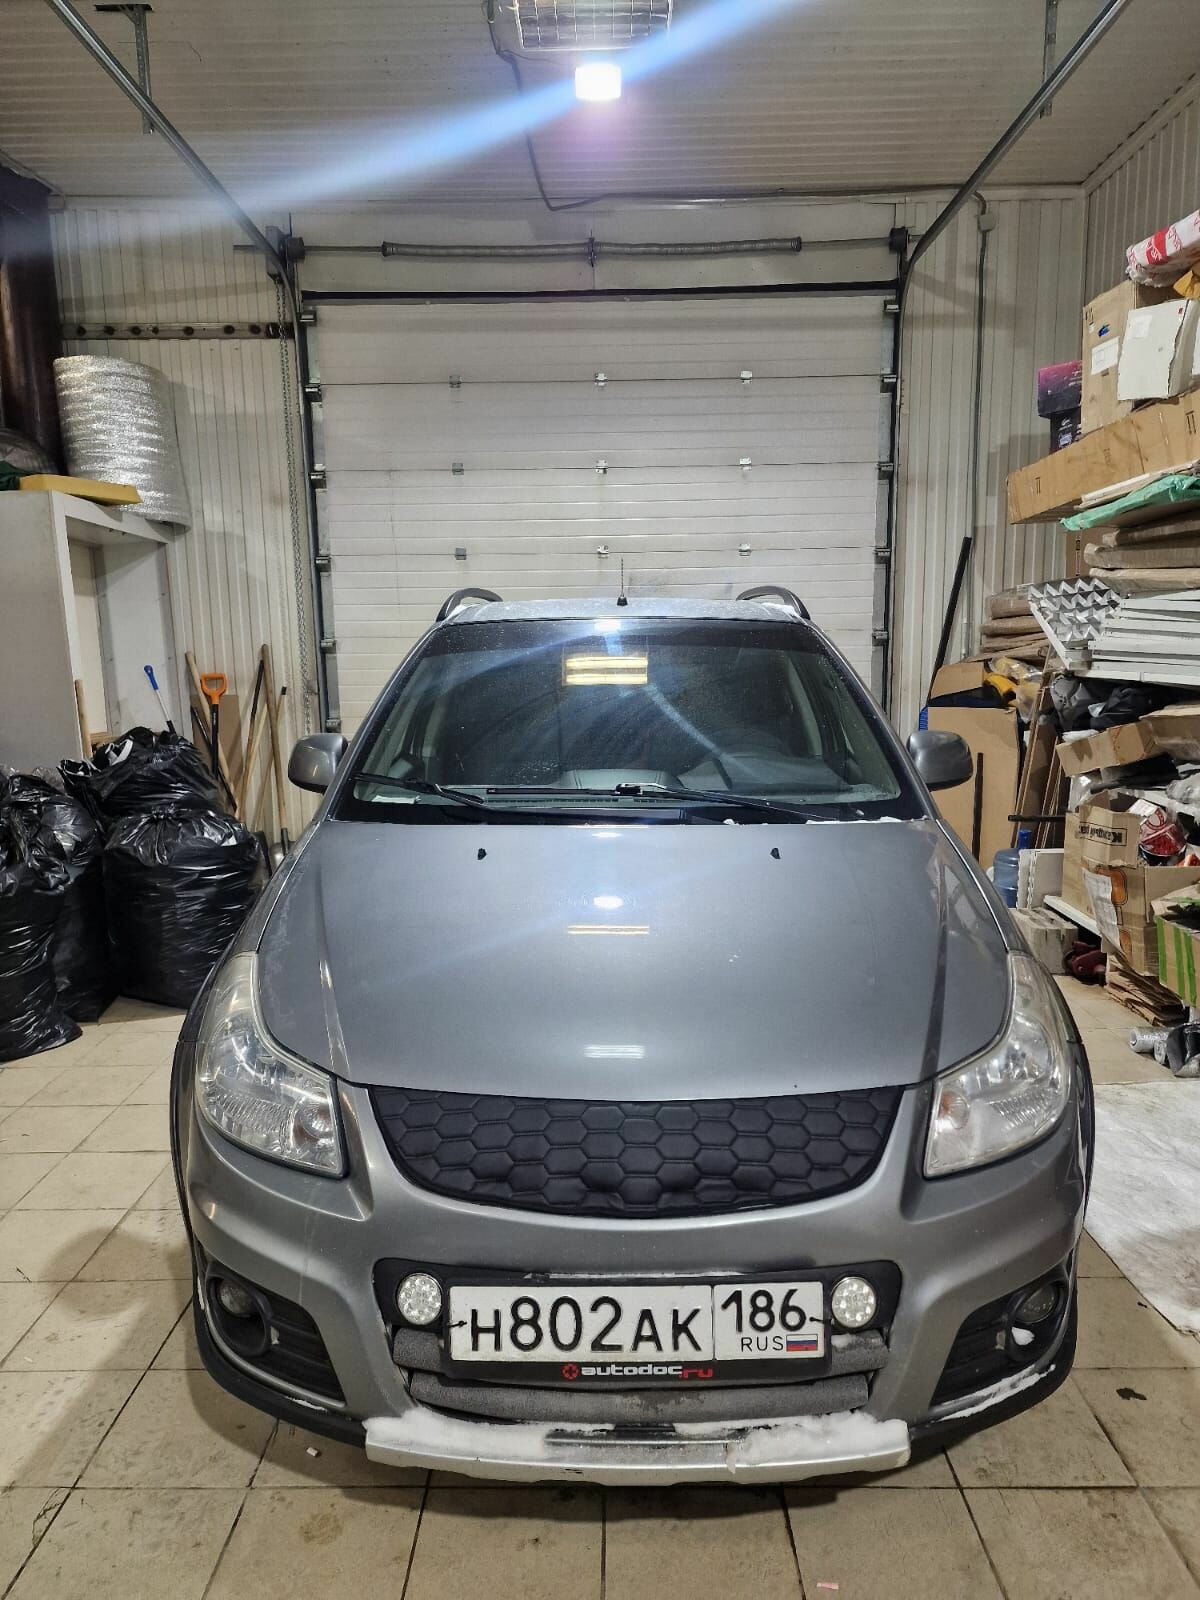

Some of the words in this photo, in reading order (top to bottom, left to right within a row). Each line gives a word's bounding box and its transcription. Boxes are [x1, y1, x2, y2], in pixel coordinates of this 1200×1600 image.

[720, 1288, 807, 1333] 186
[740, 1335, 784, 1352] RUS
[580, 1363, 714, 1379] autodoc.ru
